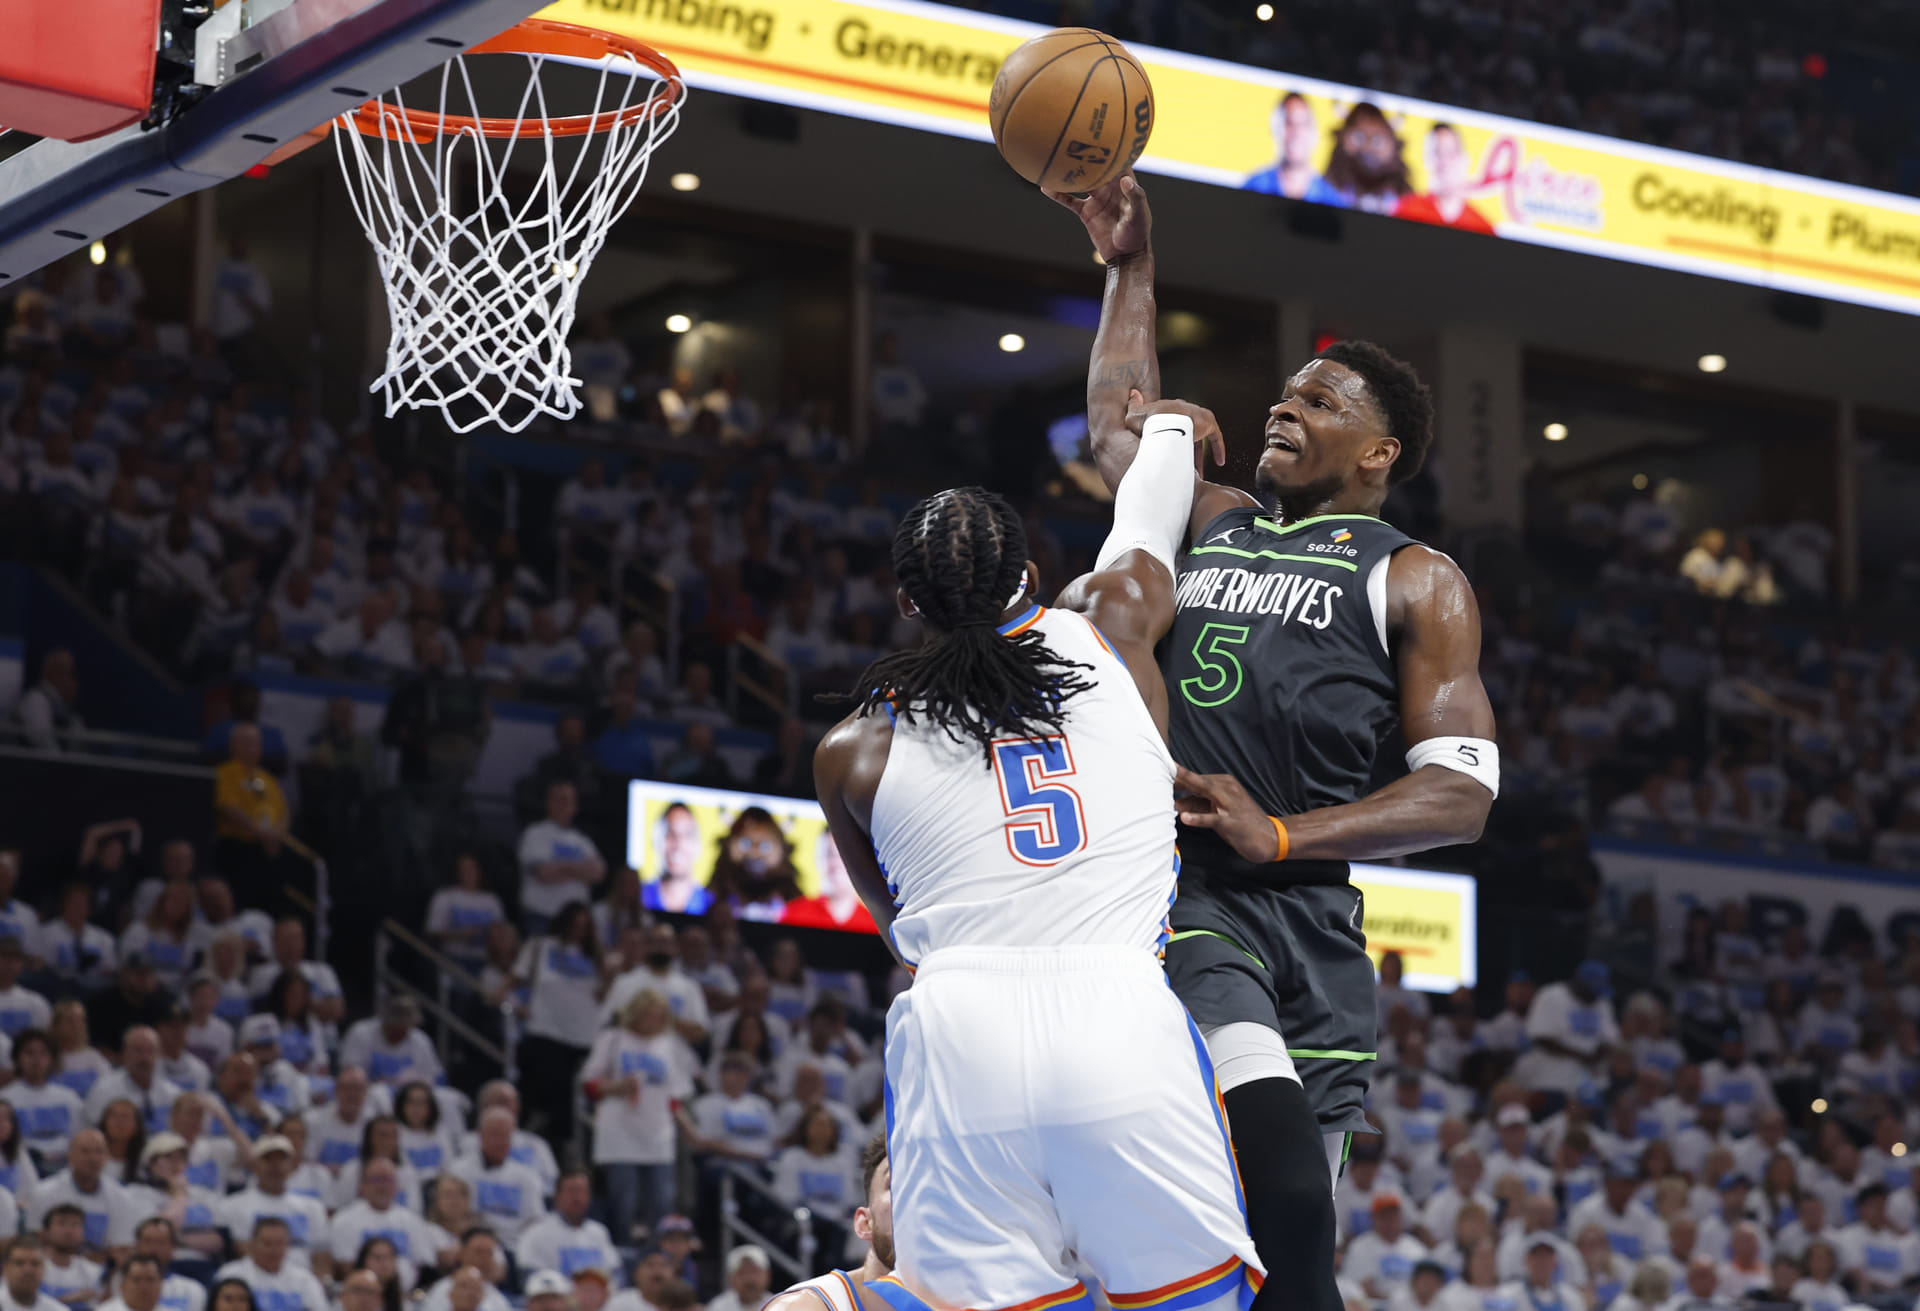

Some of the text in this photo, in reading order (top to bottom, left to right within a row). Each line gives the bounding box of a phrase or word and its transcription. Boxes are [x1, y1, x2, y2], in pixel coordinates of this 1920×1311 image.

[1632, 171, 1782, 246] Cooling
[1306, 541, 1358, 558] sezzle
[1180, 622, 1250, 708] 5
[1457, 744, 1480, 767] 5
[990, 734, 1089, 868] 5
